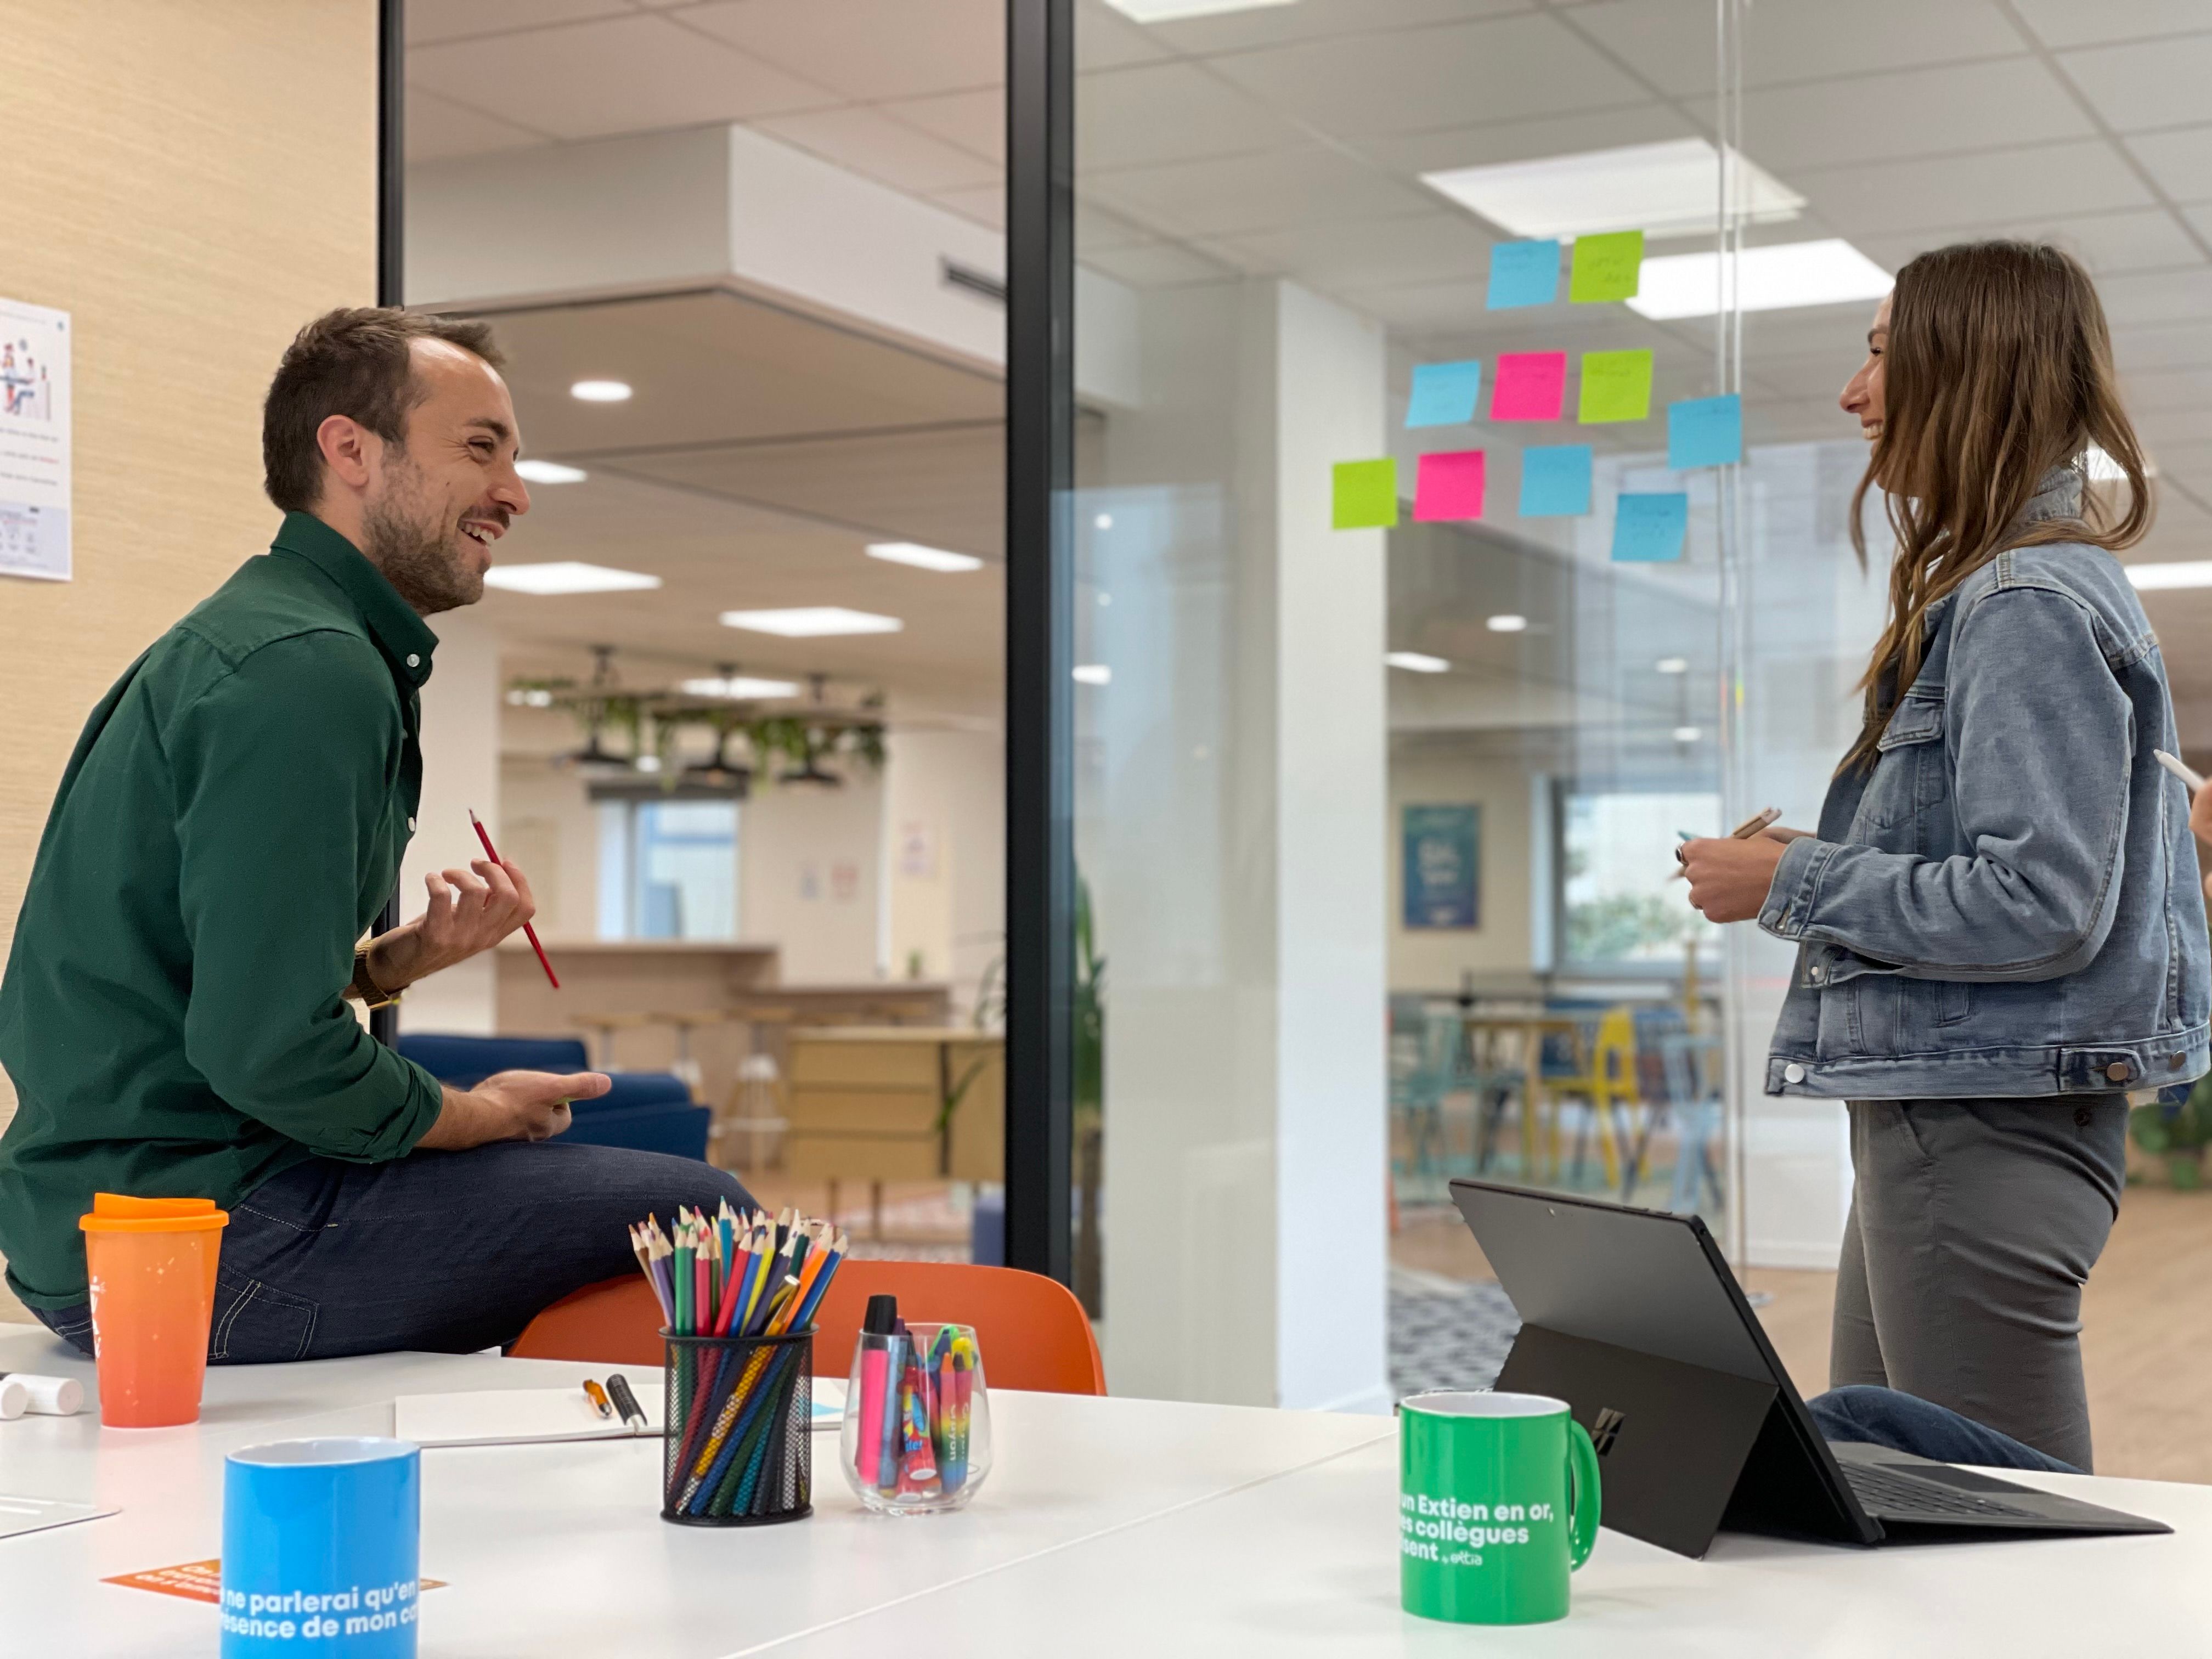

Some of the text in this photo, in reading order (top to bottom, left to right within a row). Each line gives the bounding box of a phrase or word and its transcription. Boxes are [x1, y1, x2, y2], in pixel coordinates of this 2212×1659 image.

[1418, 1494, 1488, 1521] Extien
[1494, 1504, 1525, 1522] en
[1529, 1503, 1554, 1523] or,
[1416, 1520, 1529, 1549] collègues
[227, 1589, 246, 1609] ne
[250, 1586, 359, 1617] parlerai
[365, 1581, 416, 1611] qu'en
[302, 1615, 340, 1638] de
[346, 1611, 396, 1635] mon
